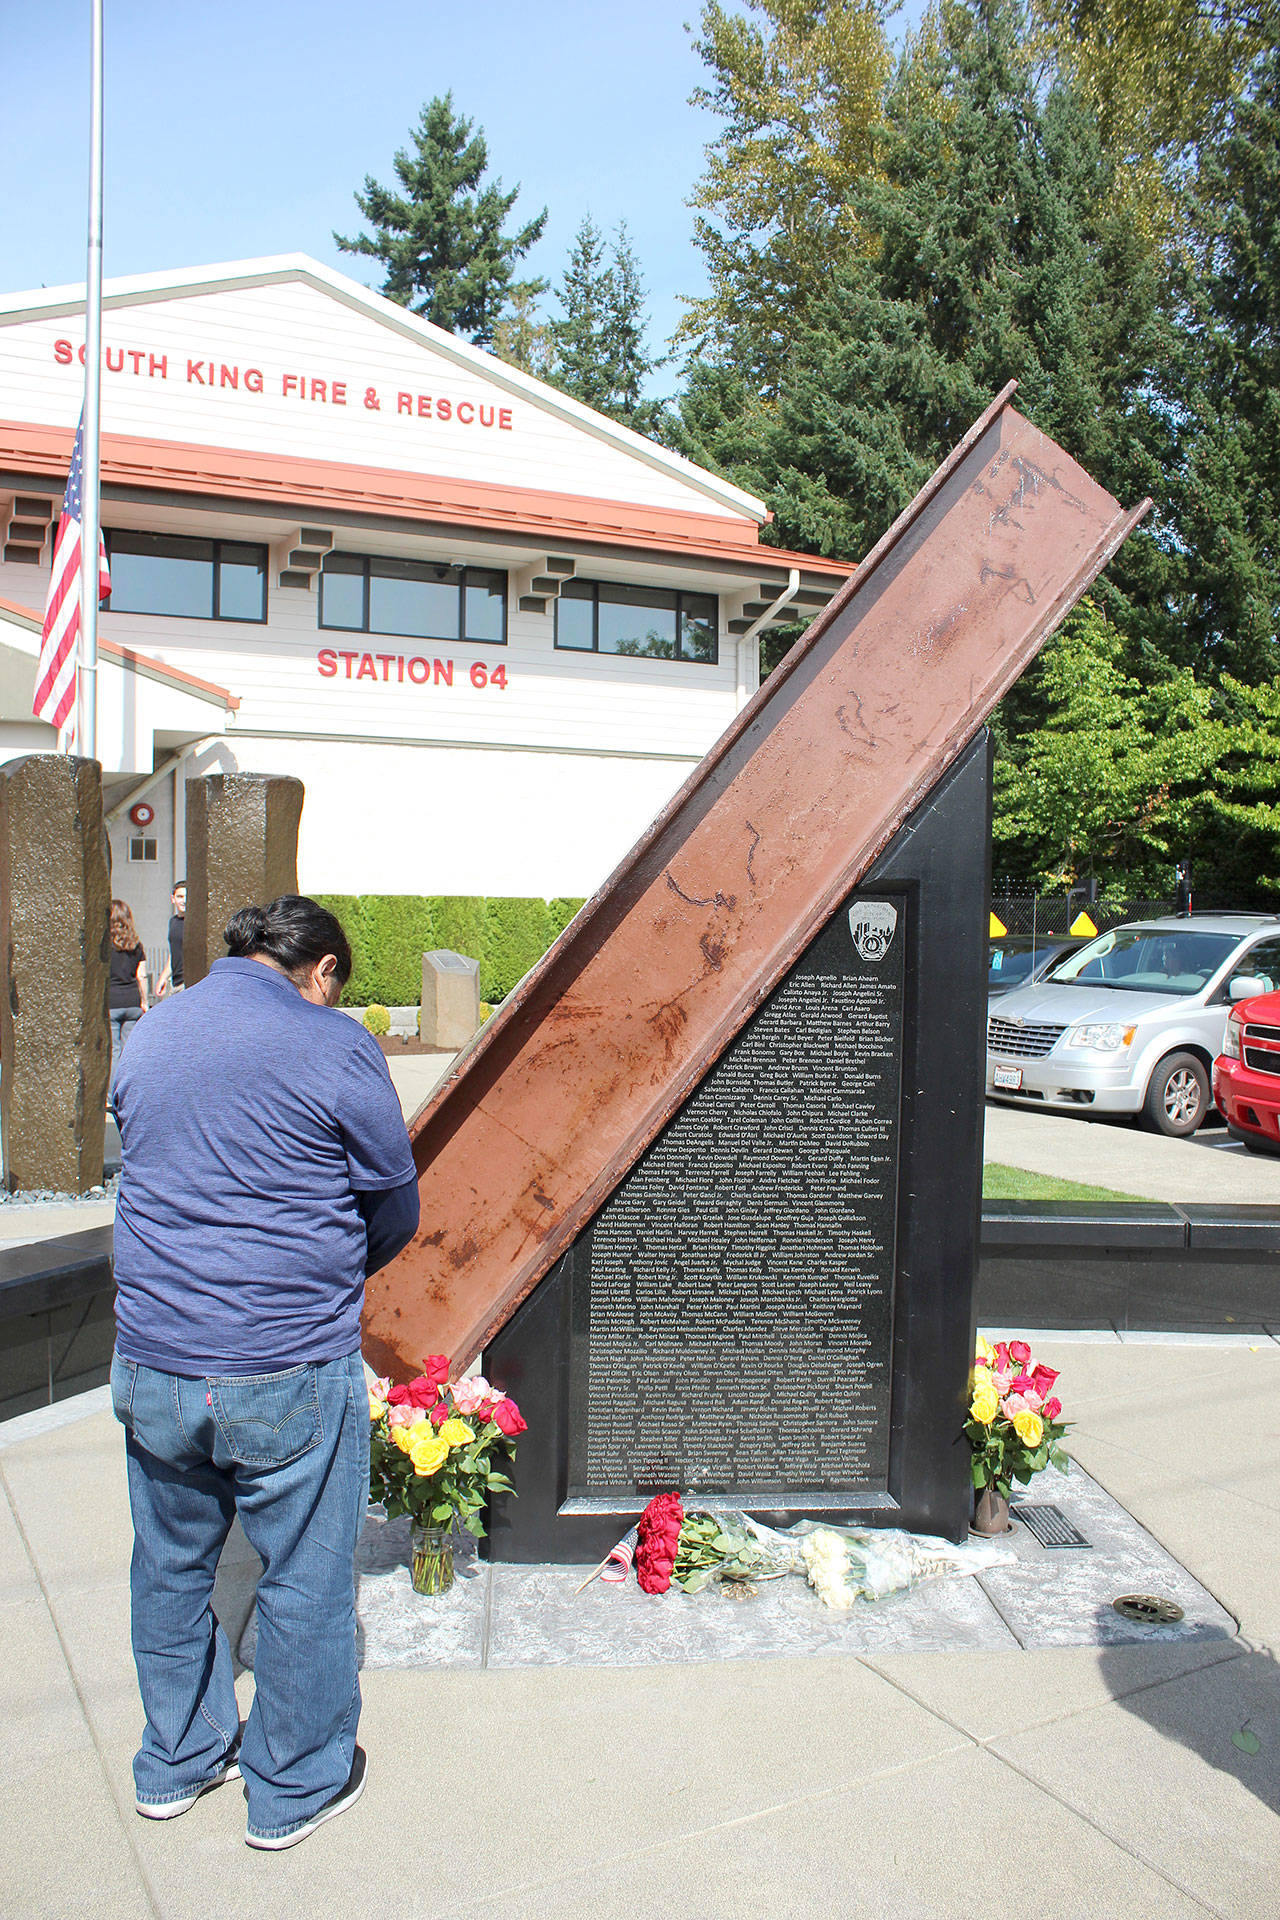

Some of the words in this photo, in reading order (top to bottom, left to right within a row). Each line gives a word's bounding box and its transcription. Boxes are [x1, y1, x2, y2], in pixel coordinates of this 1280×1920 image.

[187, 359, 264, 393] KING
[283, 374, 347, 405] FIRE
[364, 387, 381, 411] &
[397, 391, 513, 431] RESCUE
[317, 648, 454, 687] STATION
[469, 661, 509, 690] 64
[816, 974, 837, 982] Agnello
[804, 989, 821, 997] Anaya
[778, 996, 797, 1004] Joseph
[764, 1011, 781, 1019] Gregg
[875, 1020, 890, 1028] Barry
[837, 1027, 860, 1035] Stephen
[797, 1034, 813, 1042] Beyer
[735, 1169, 754, 1177] Joseph
